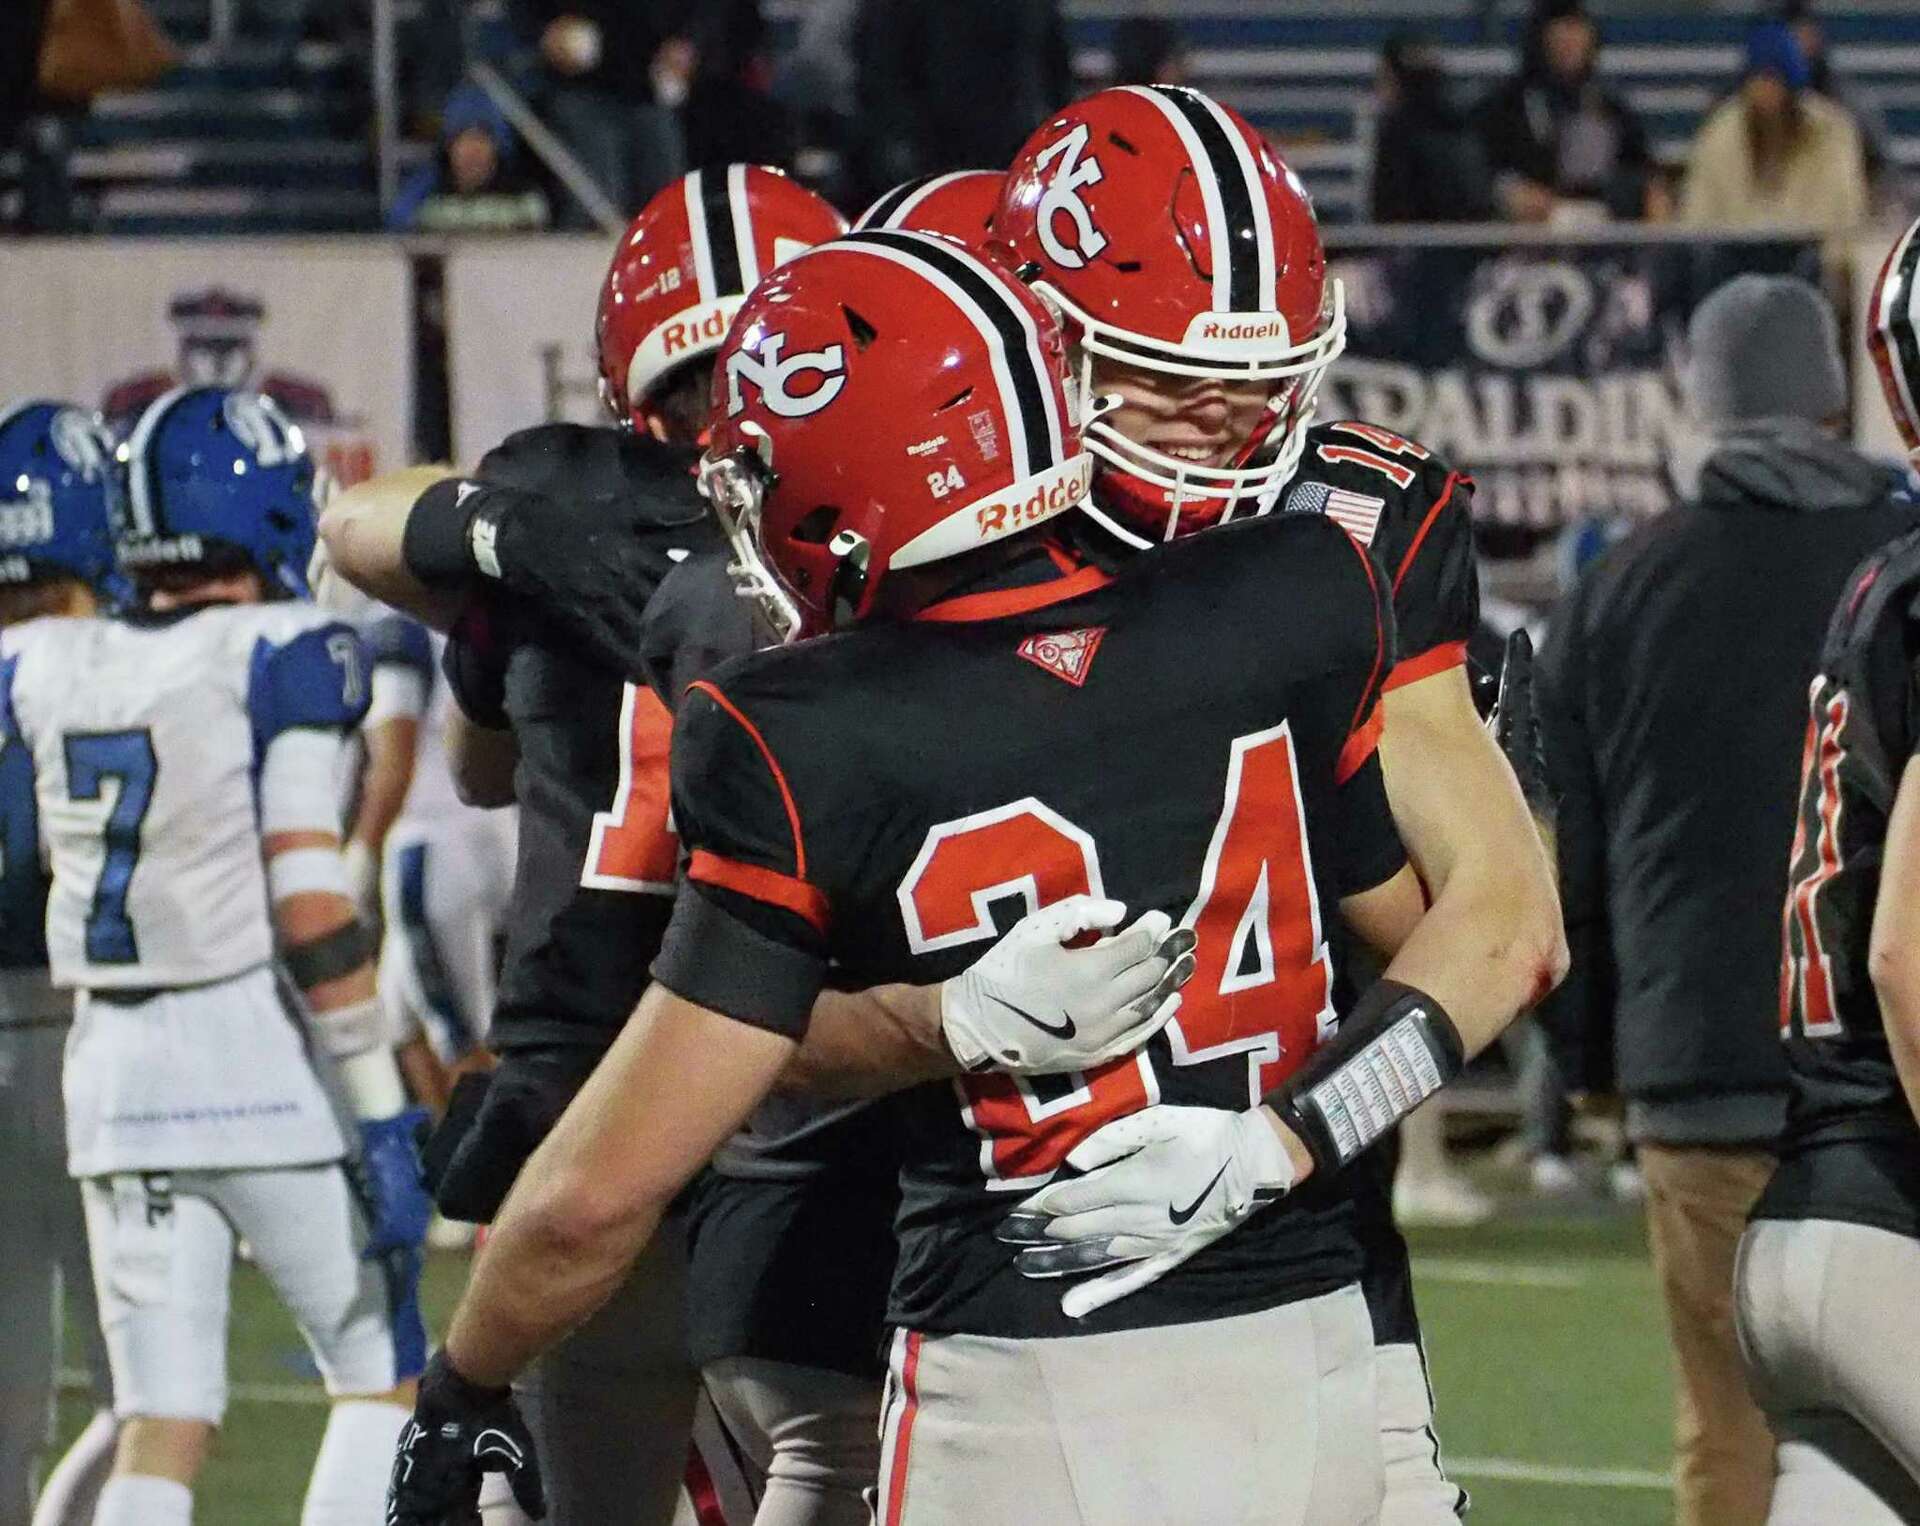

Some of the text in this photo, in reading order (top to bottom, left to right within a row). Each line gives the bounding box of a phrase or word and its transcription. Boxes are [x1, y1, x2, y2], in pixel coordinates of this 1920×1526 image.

[1035, 123, 1108, 269] NC
[661, 308, 737, 357] Rid
[1203, 322, 1280, 338] Riddell
[725, 331, 846, 419] NC
[926, 464, 965, 499] 24
[65, 726, 158, 965] 7
[896, 719, 1338, 1191] 24
